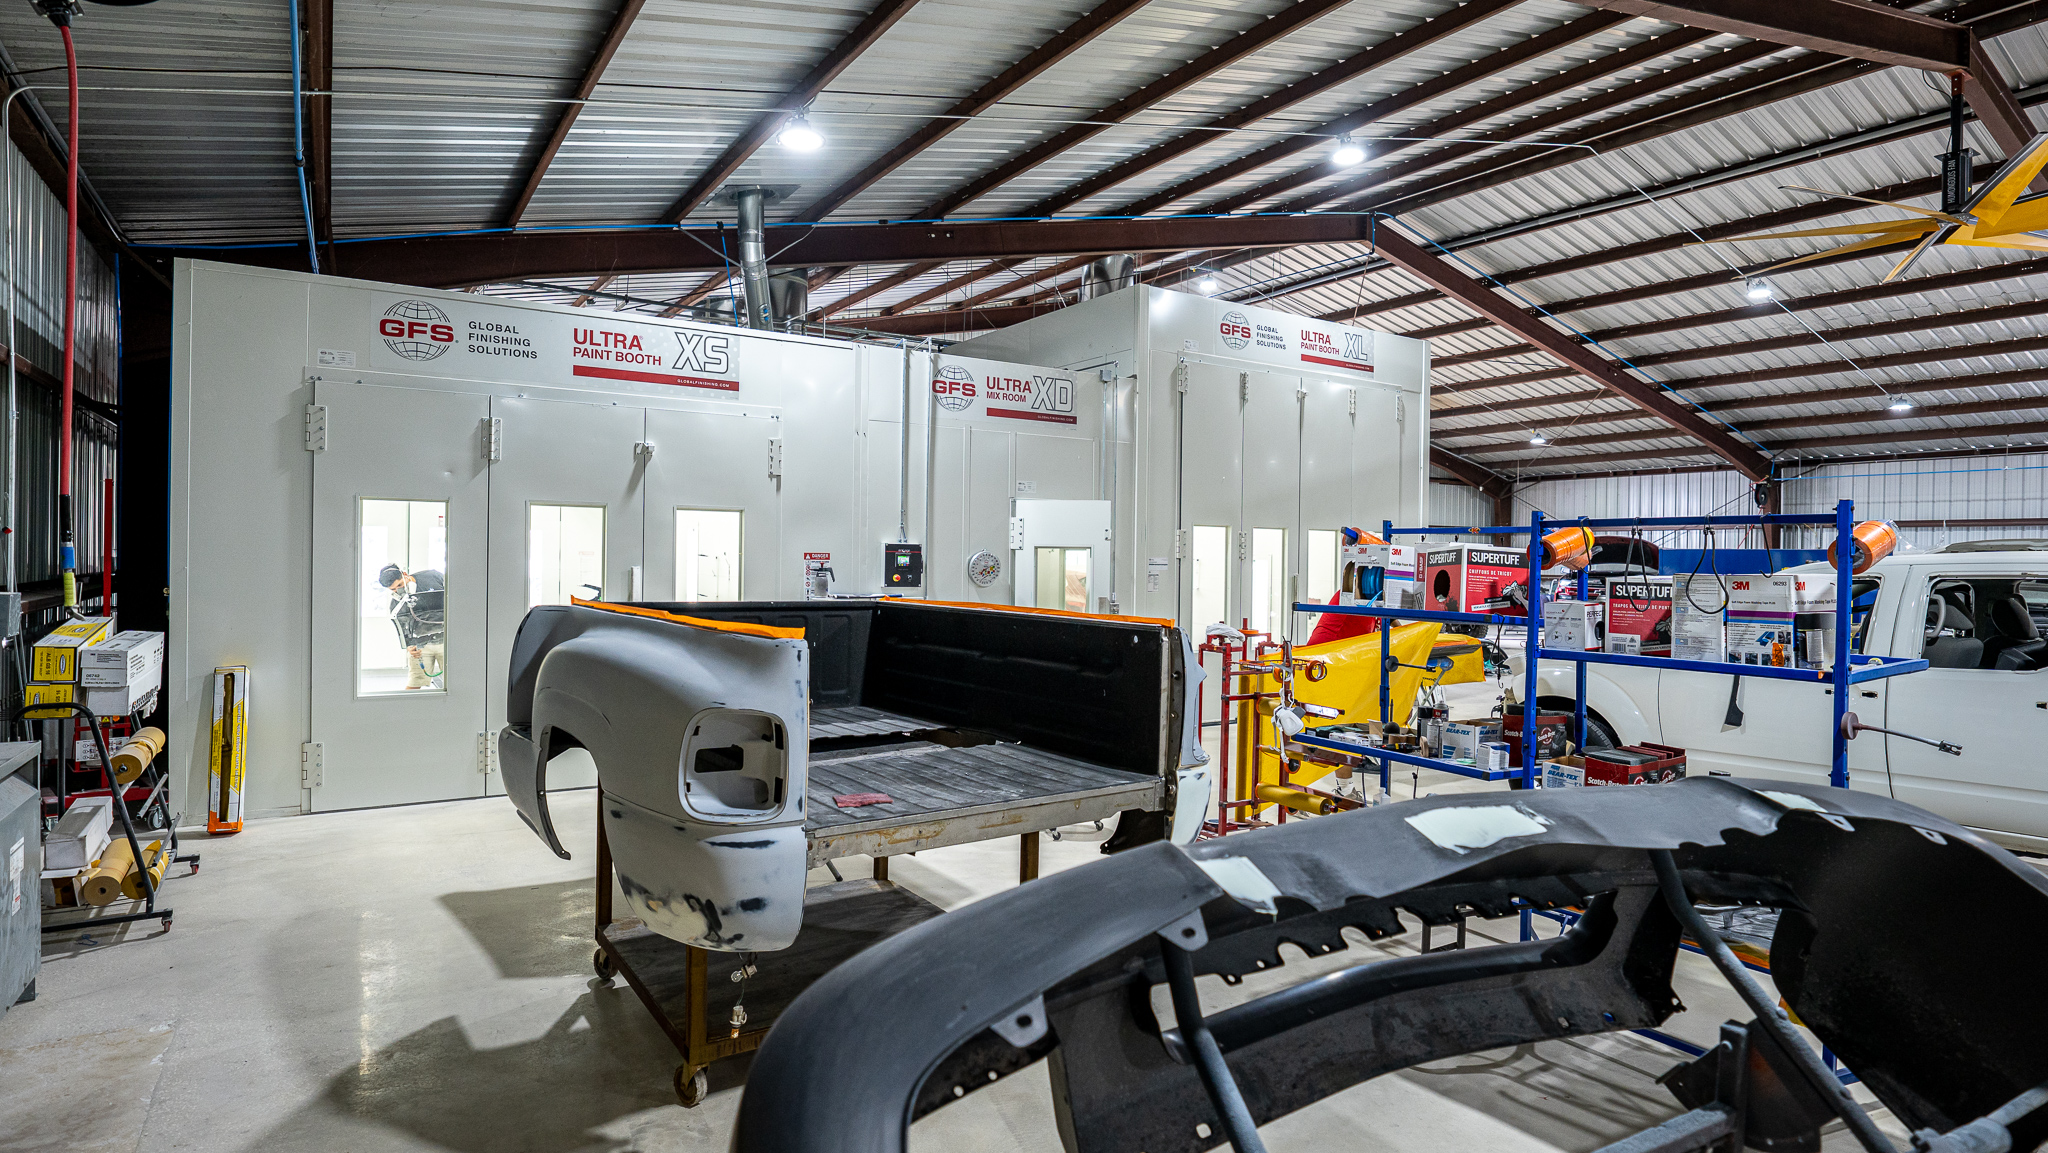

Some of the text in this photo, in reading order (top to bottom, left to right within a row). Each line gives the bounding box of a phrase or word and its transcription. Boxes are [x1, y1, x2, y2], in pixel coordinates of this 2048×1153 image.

[1947, 159, 1956, 204] HUMONGOUS FAN
[379, 318, 454, 343] GFS
[468, 321, 519, 334] GLOBAL
[1220, 322, 1251, 339] GFS
[1256, 324, 1279, 334] GLOBAL
[468, 333, 531, 347] FINISHING
[573, 328, 643, 351] ULTRA
[1256, 332, 1284, 342] FINISHING
[1301, 330, 1331, 345] ULTRA
[468, 344, 538, 359] SOLUTIONS
[1256, 340, 1287, 350] SOLUTIONS
[1301, 342, 1340, 355] PAINT BOOTH
[1344, 332, 1367, 361] XL
[573, 347, 662, 366] PAINT BOOTH
[672, 331, 729, 374] XS
[677, 378, 730, 388] GLOBALFINISHING.COM
[932, 379, 976, 397] GFS
[986, 376, 1032, 394] ULTRA
[986, 391, 1026, 403] MIX ROOM
[1031, 375, 1074, 413] XD
[1429, 552, 1457, 564] SUPERTUFF
[1472, 552, 1520, 565] SUPERTUFF
[1732, 581, 1750, 590] 3M
[1795, 582, 1805, 591] 3M
[1547, 770, 1578, 780] BEAR-TEX
